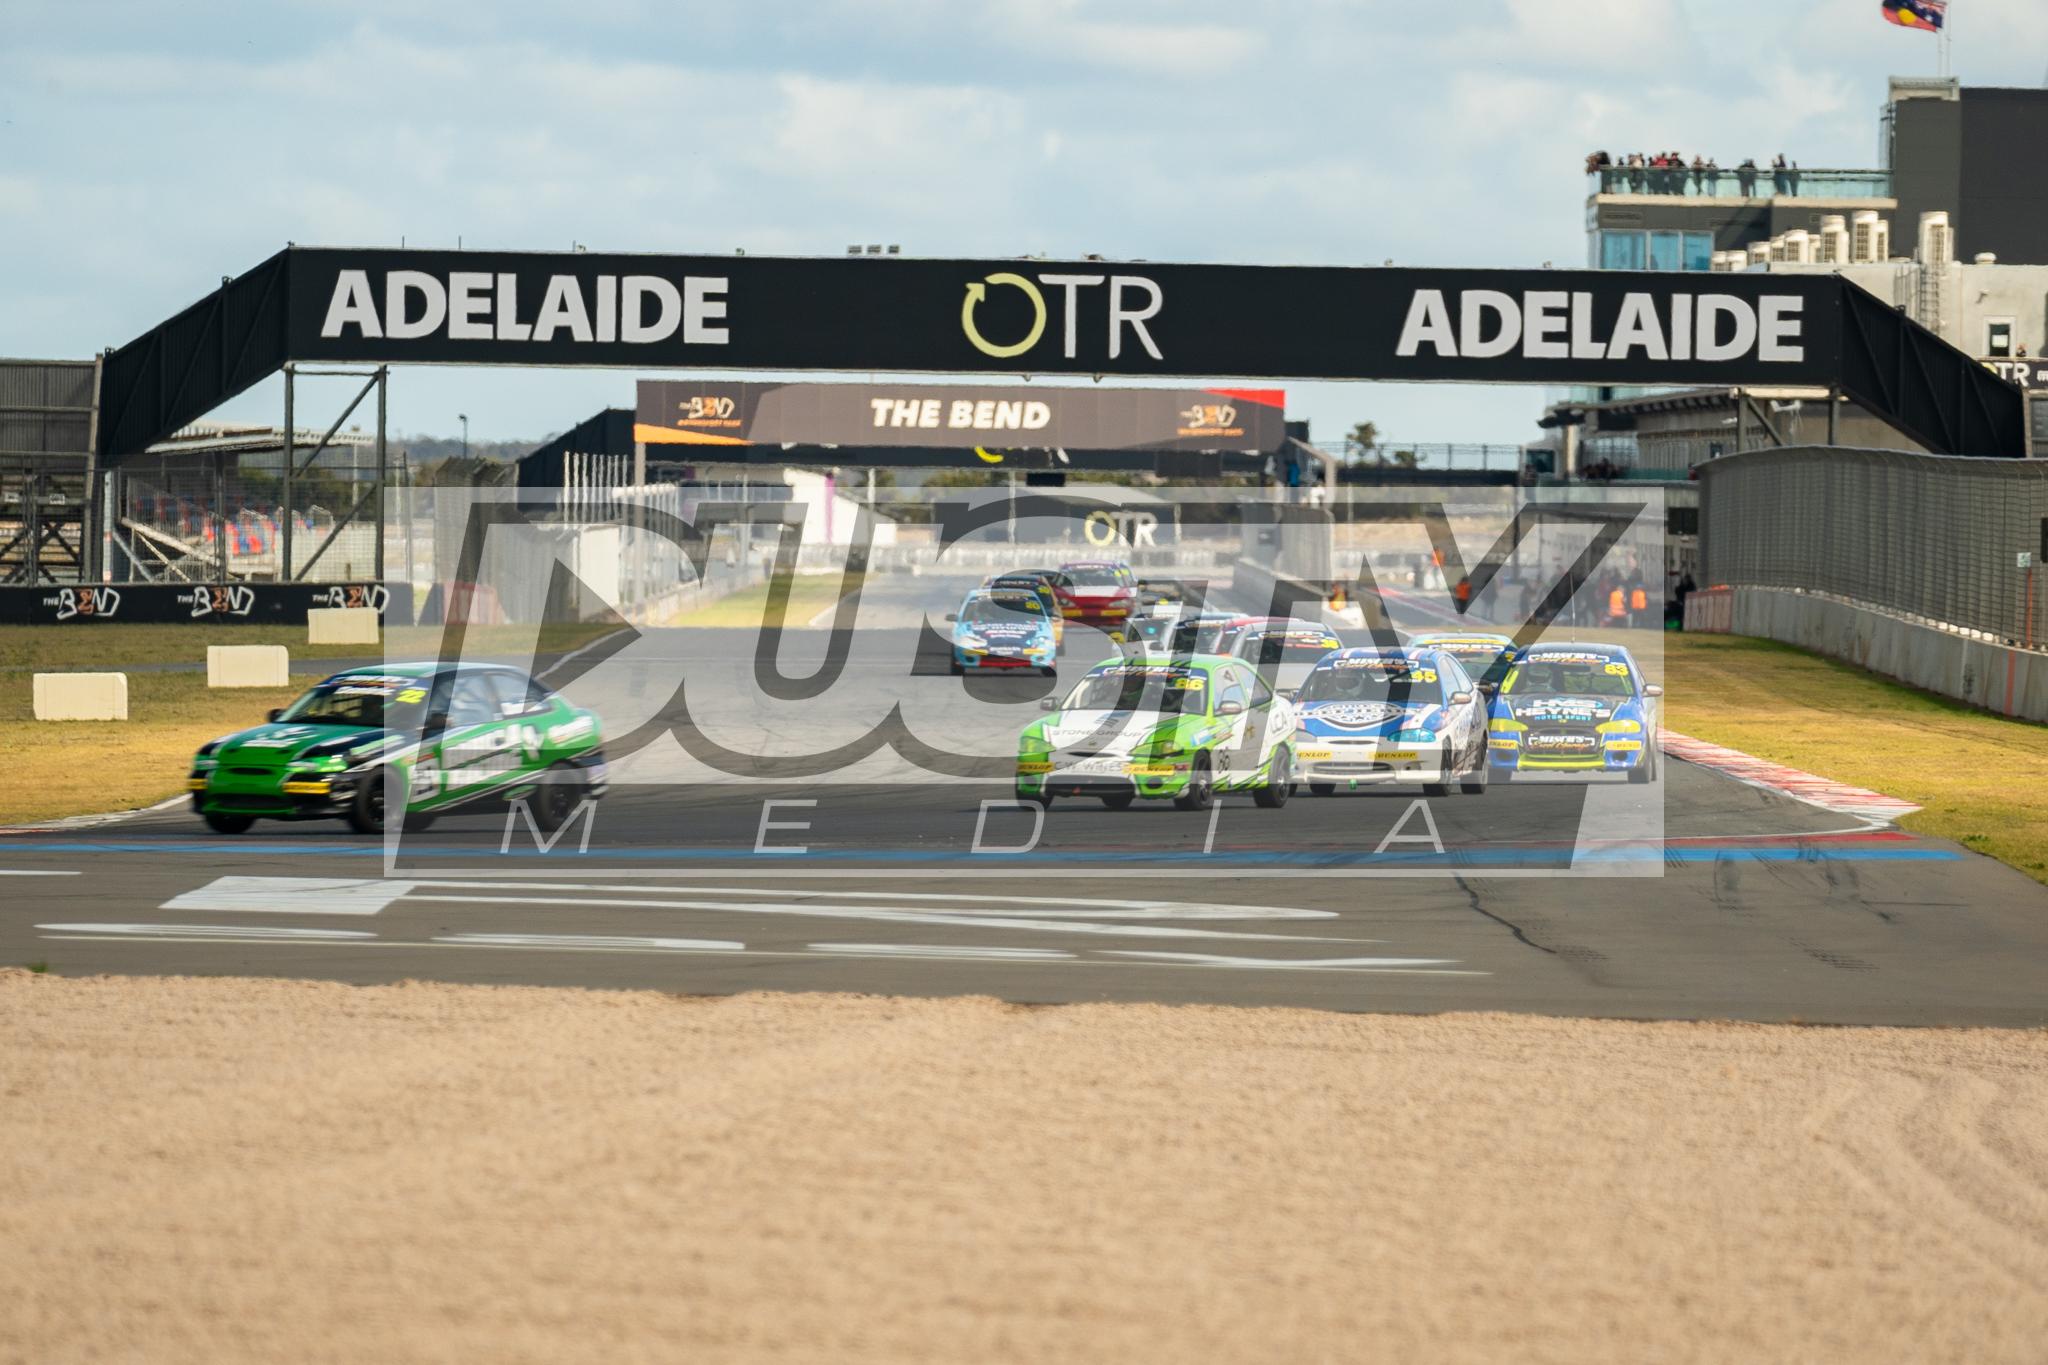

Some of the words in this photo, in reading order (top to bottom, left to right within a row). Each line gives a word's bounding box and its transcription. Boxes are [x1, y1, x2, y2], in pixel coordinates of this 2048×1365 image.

[321, 270, 729, 344] ADELAIDE
[962, 272, 1164, 360] OTR
[1396, 289, 1804, 362] ADELAIDE
[1981, 362, 2031, 387] TR
[871, 398, 941, 428] THE
[949, 399, 1050, 429] BEND
[1084, 510, 1158, 548] OTR
[57, 587, 120, 620] BEND
[191, 586, 254, 617] BEND
[396, 689, 427, 704] 22
[1175, 678, 1205, 691] 86
